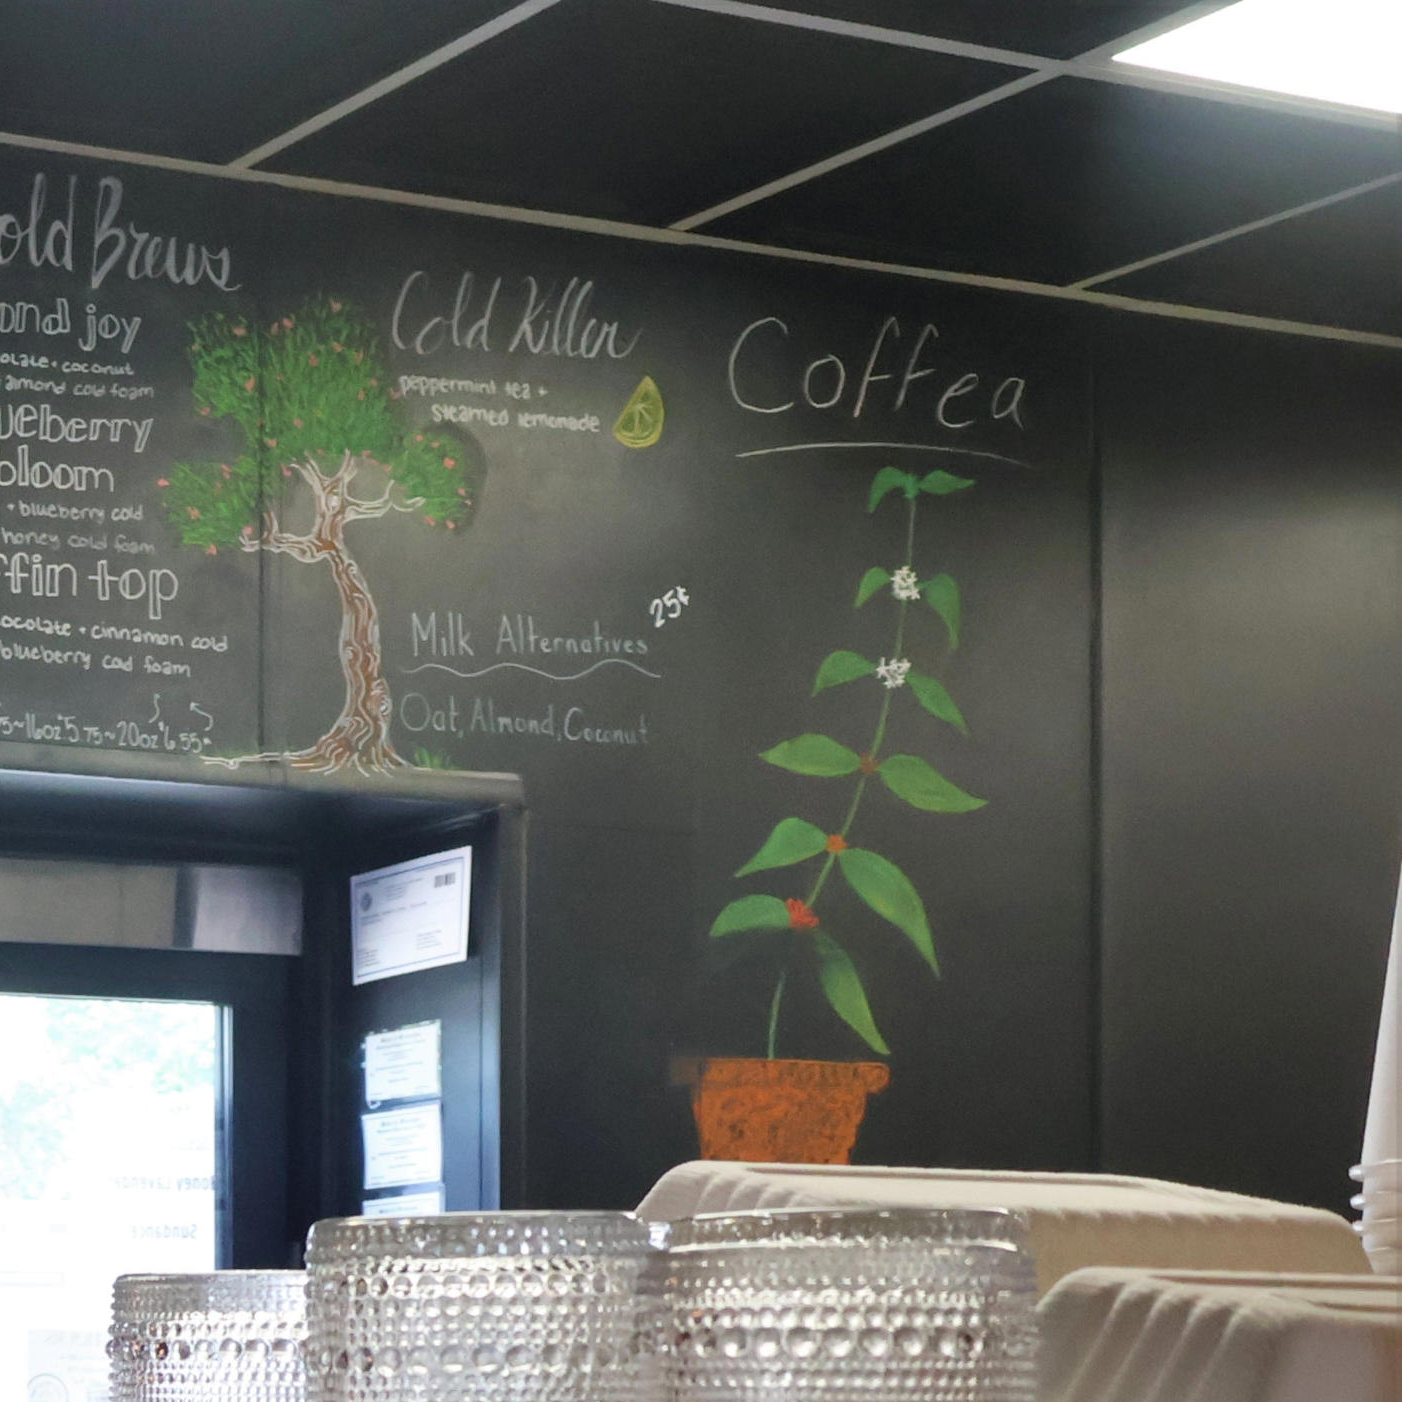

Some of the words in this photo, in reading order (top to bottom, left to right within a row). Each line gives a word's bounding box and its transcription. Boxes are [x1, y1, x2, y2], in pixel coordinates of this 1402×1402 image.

[91, 175, 242, 291] Brews
[78, 304, 142, 354] joy
[391, 270, 502, 355] Cold
[728, 316, 1025, 430] Coffea
[88, 559, 179, 620] top
[90, 623, 184, 649] cinnamon
[191, 634, 229, 652] cold
[411, 611, 474, 657] Milk
[496, 613, 649, 655] Alternatives
[144, 655, 191, 677] foam
[562, 707, 649, 745] Coconut
